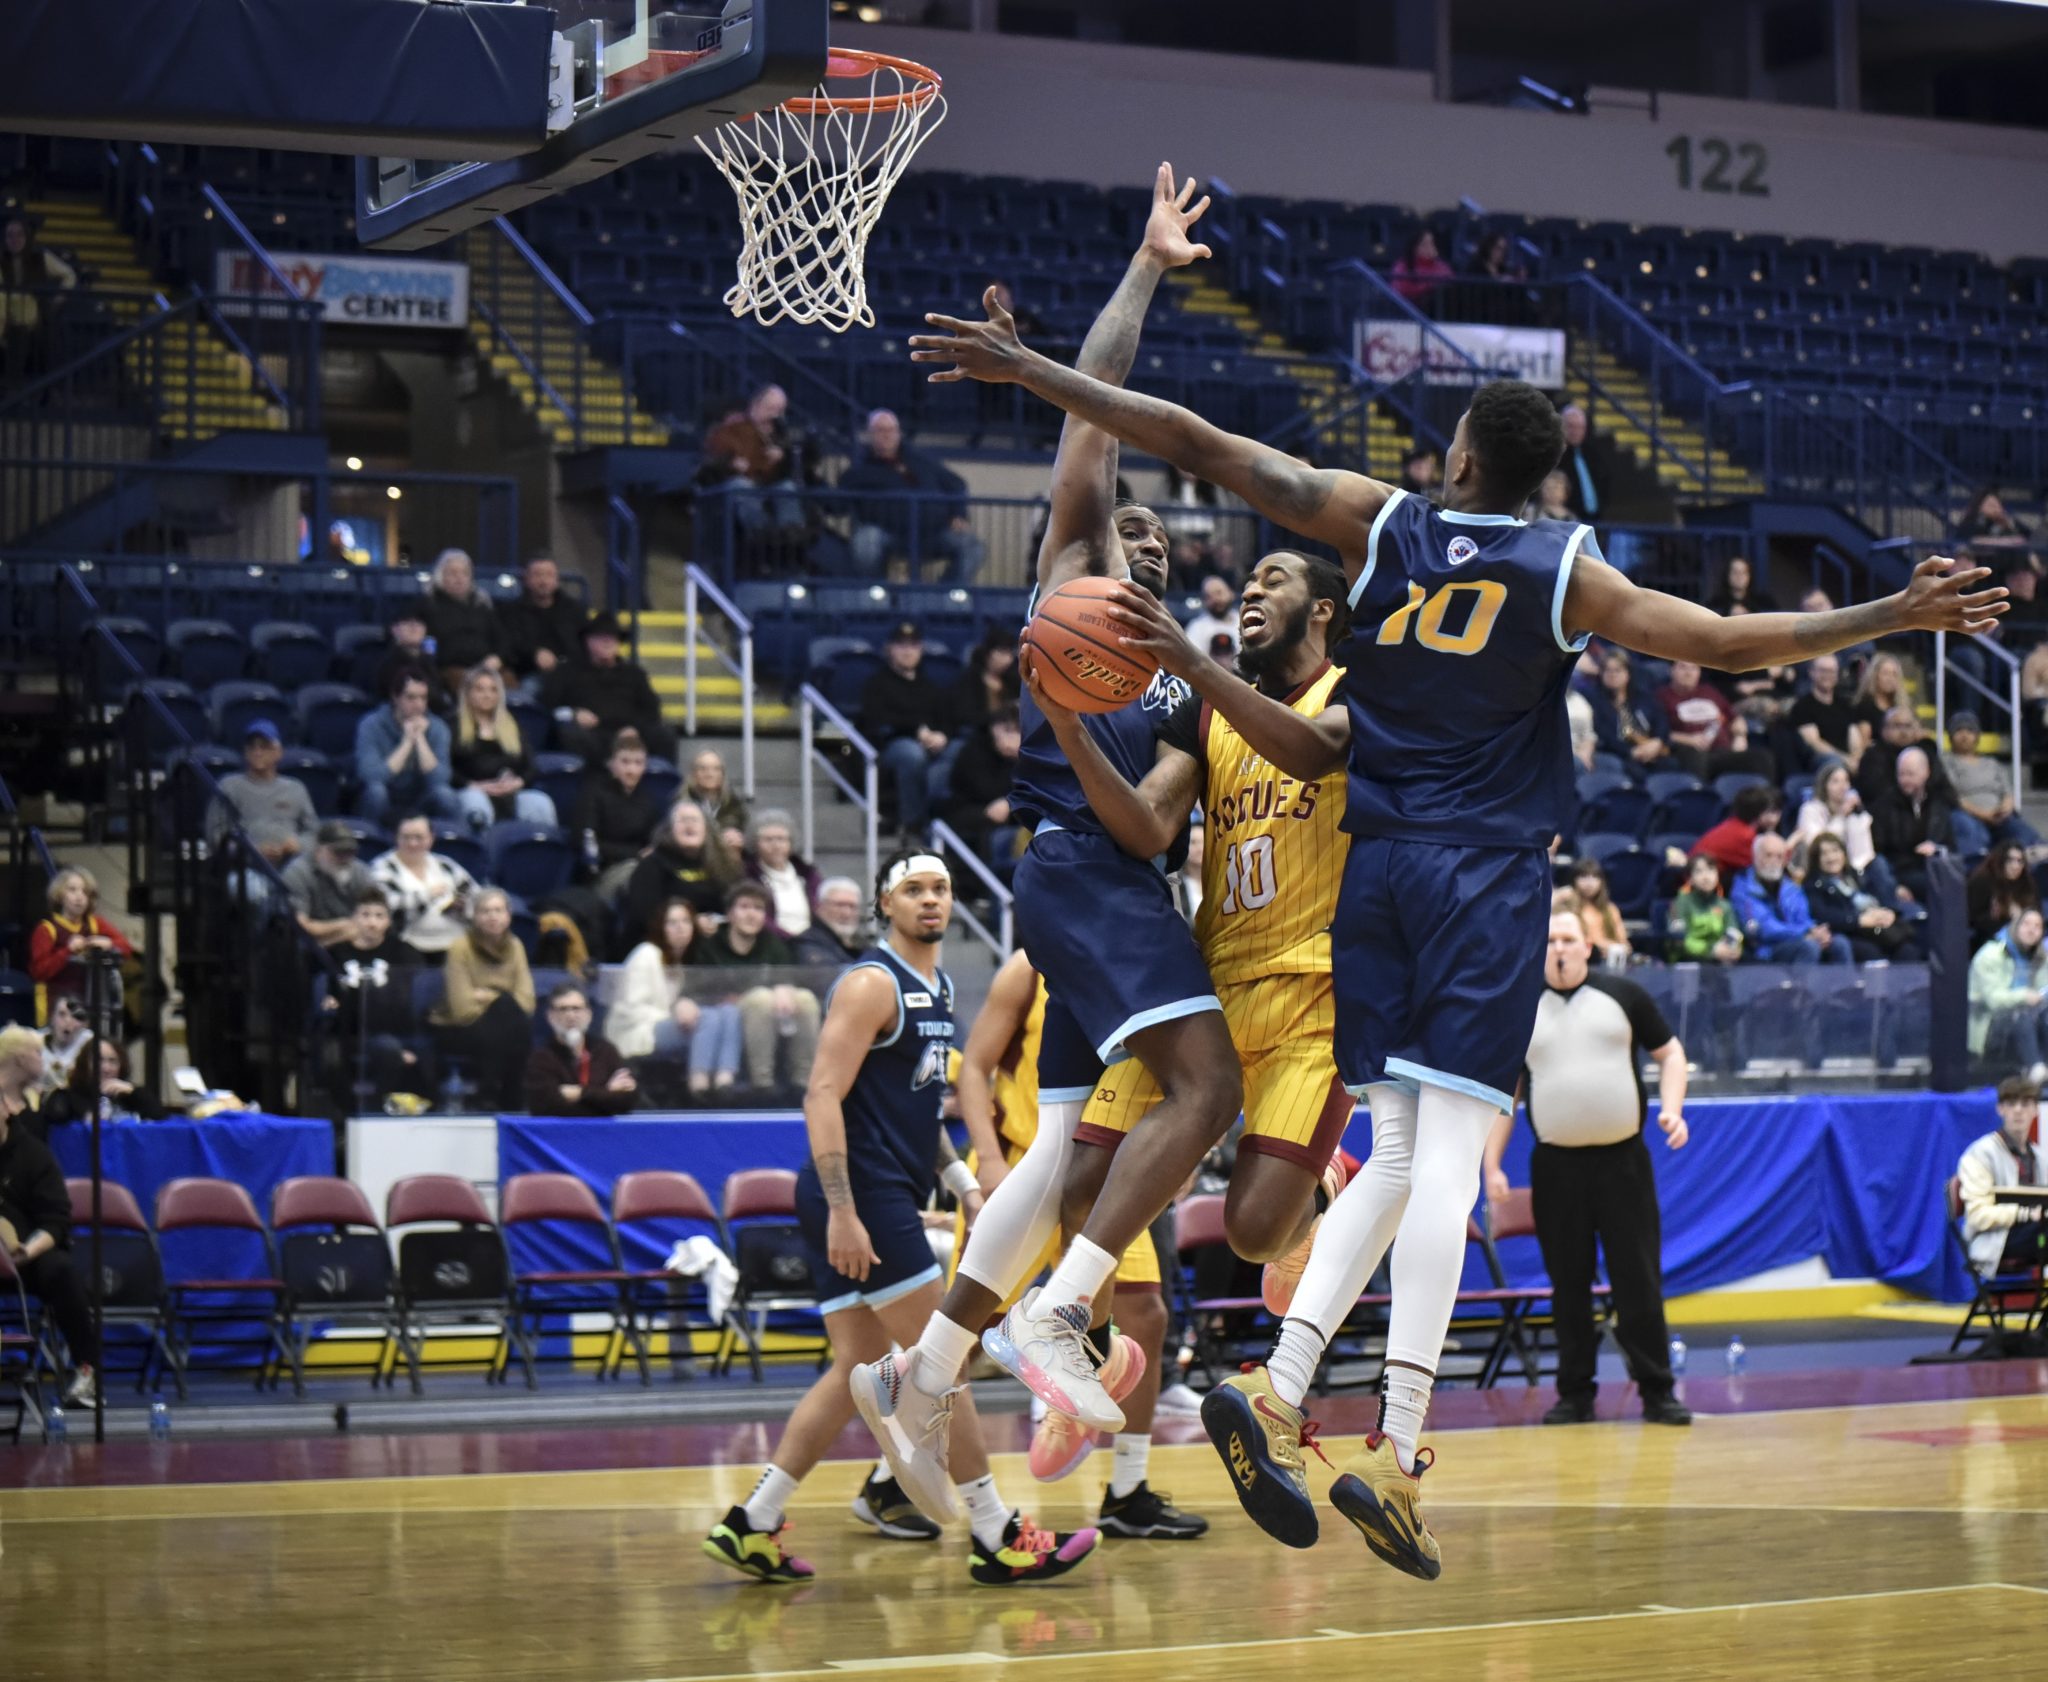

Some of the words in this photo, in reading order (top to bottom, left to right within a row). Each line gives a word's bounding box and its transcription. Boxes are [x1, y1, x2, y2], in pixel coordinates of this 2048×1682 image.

[1665, 135, 1770, 196] 122
[343, 296, 451, 322] CENTRE
[1375, 579, 1508, 656] 10
[1063, 647, 1142, 698] Baden
[1222, 833, 1278, 915] 10
